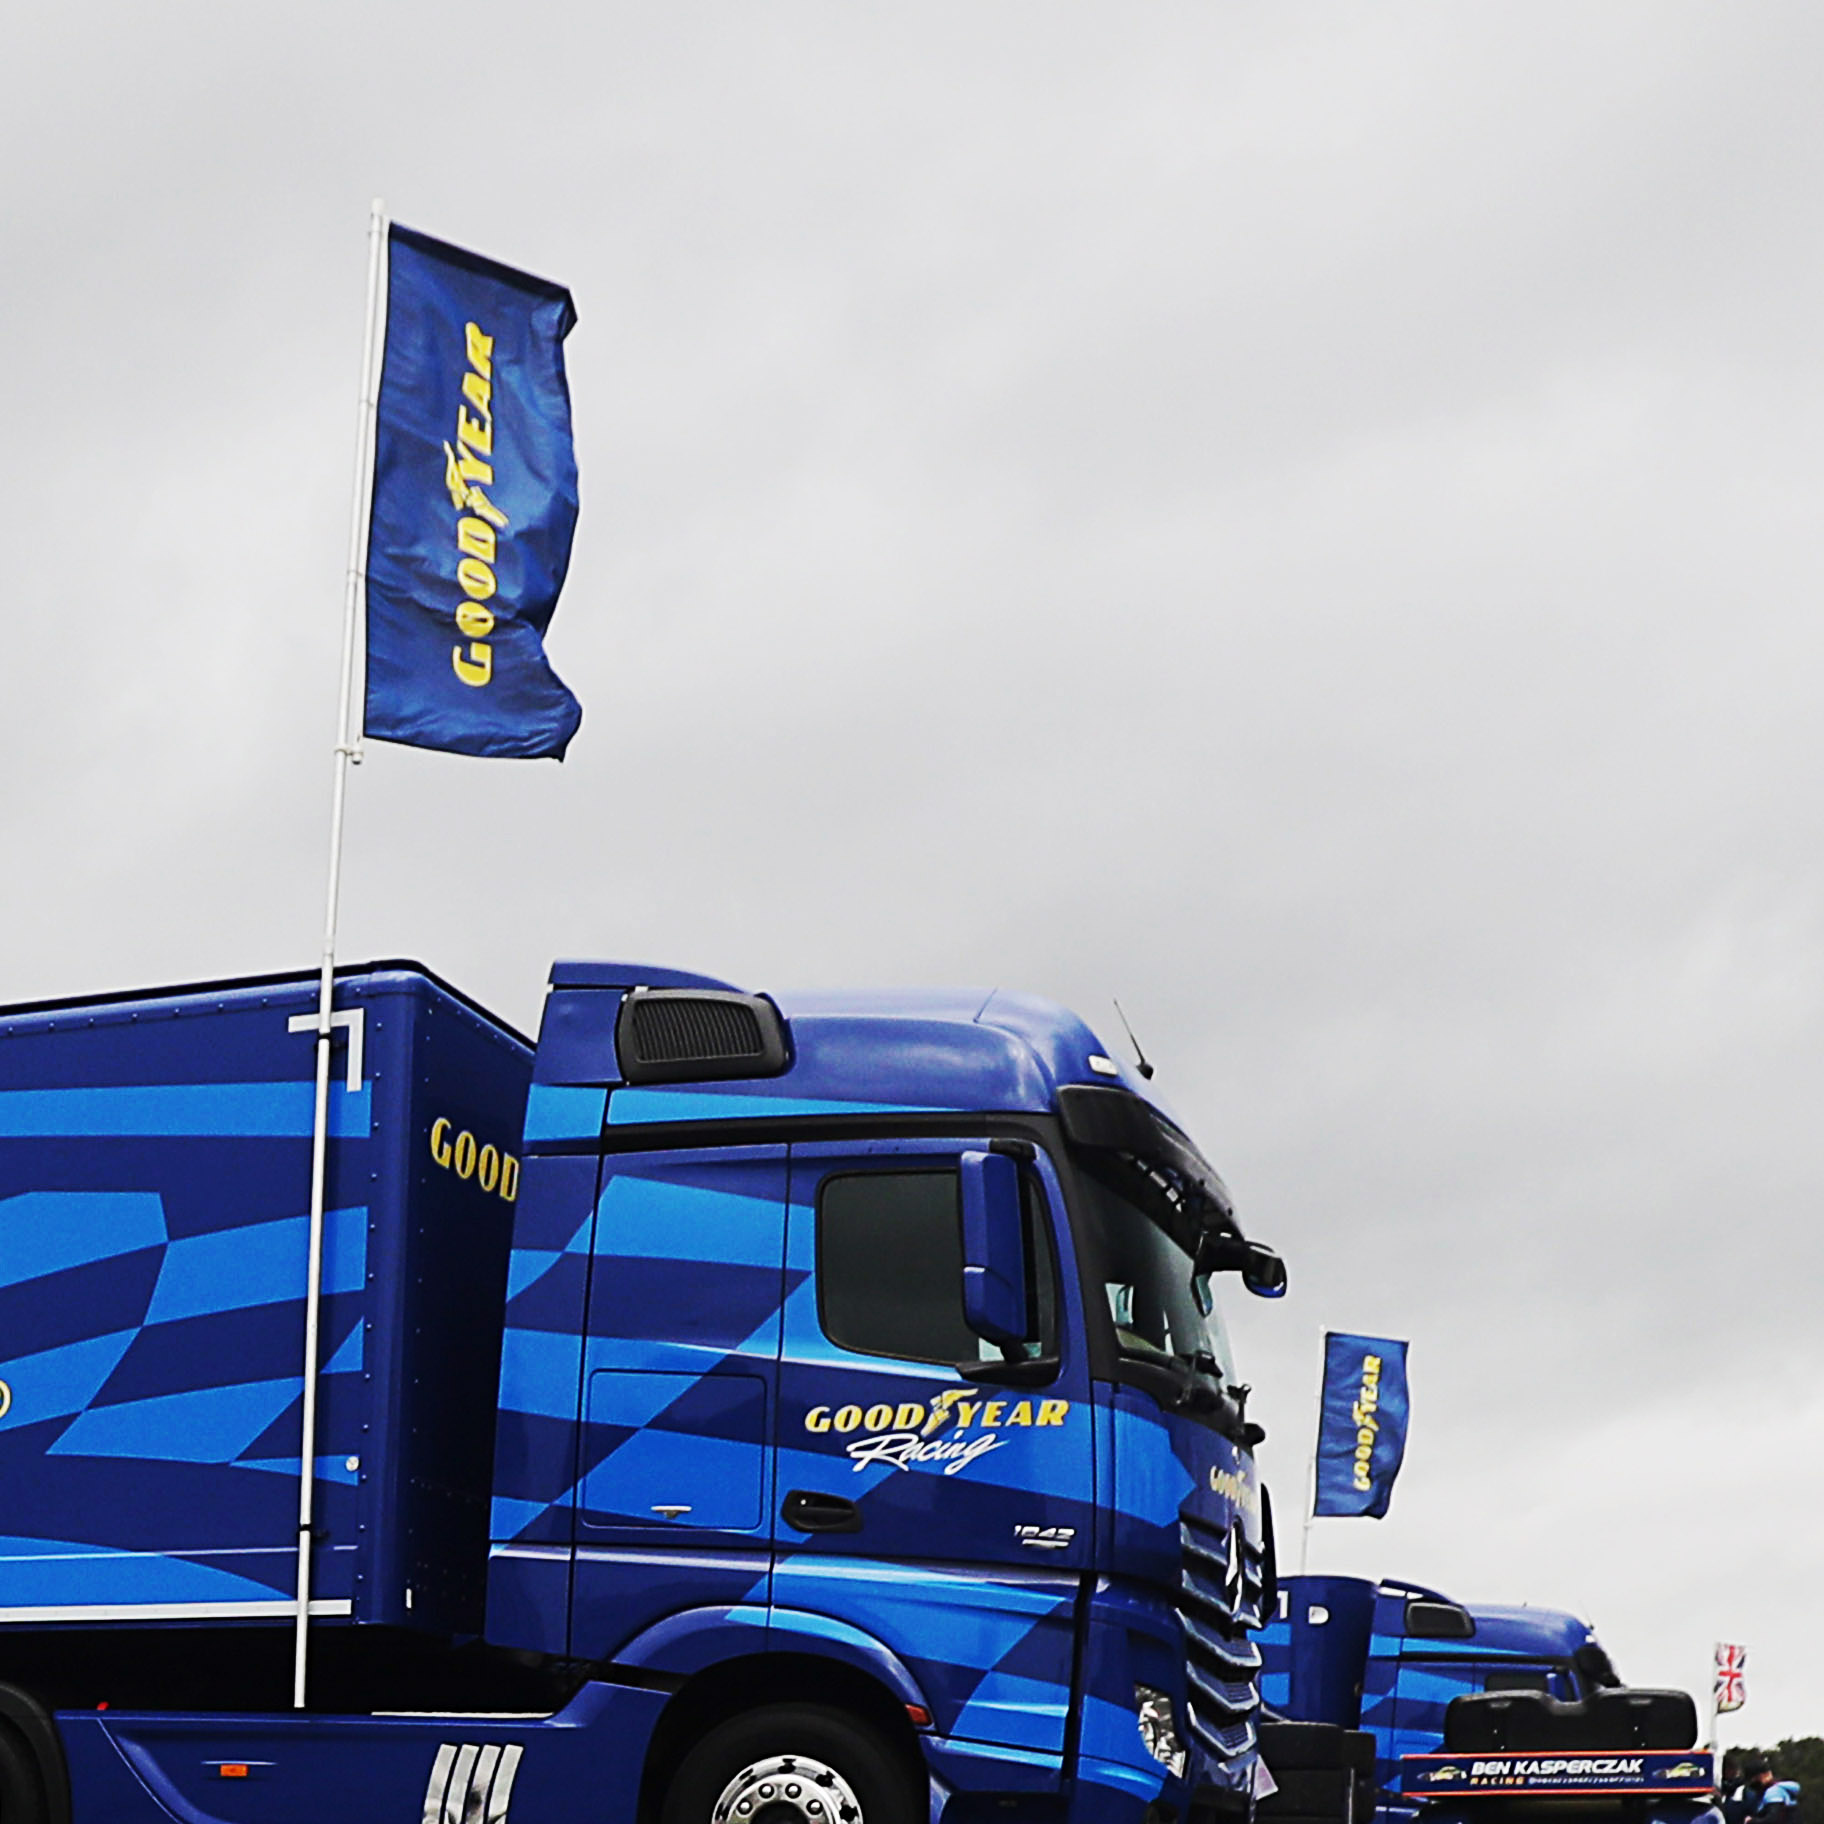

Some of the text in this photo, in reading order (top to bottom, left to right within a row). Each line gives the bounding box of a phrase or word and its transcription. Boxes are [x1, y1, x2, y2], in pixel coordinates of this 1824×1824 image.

[448, 320, 502, 687] GOODYEAR
[430, 1117, 519, 1202] GOOD
[804, 1398, 1070, 1434] GOODYEAR
[1353, 1355, 1381, 1491] GOODYEAR
[846, 1429, 1010, 1475] Racing
[1471, 1759, 1644, 1775] BEN KASPERCZAK
